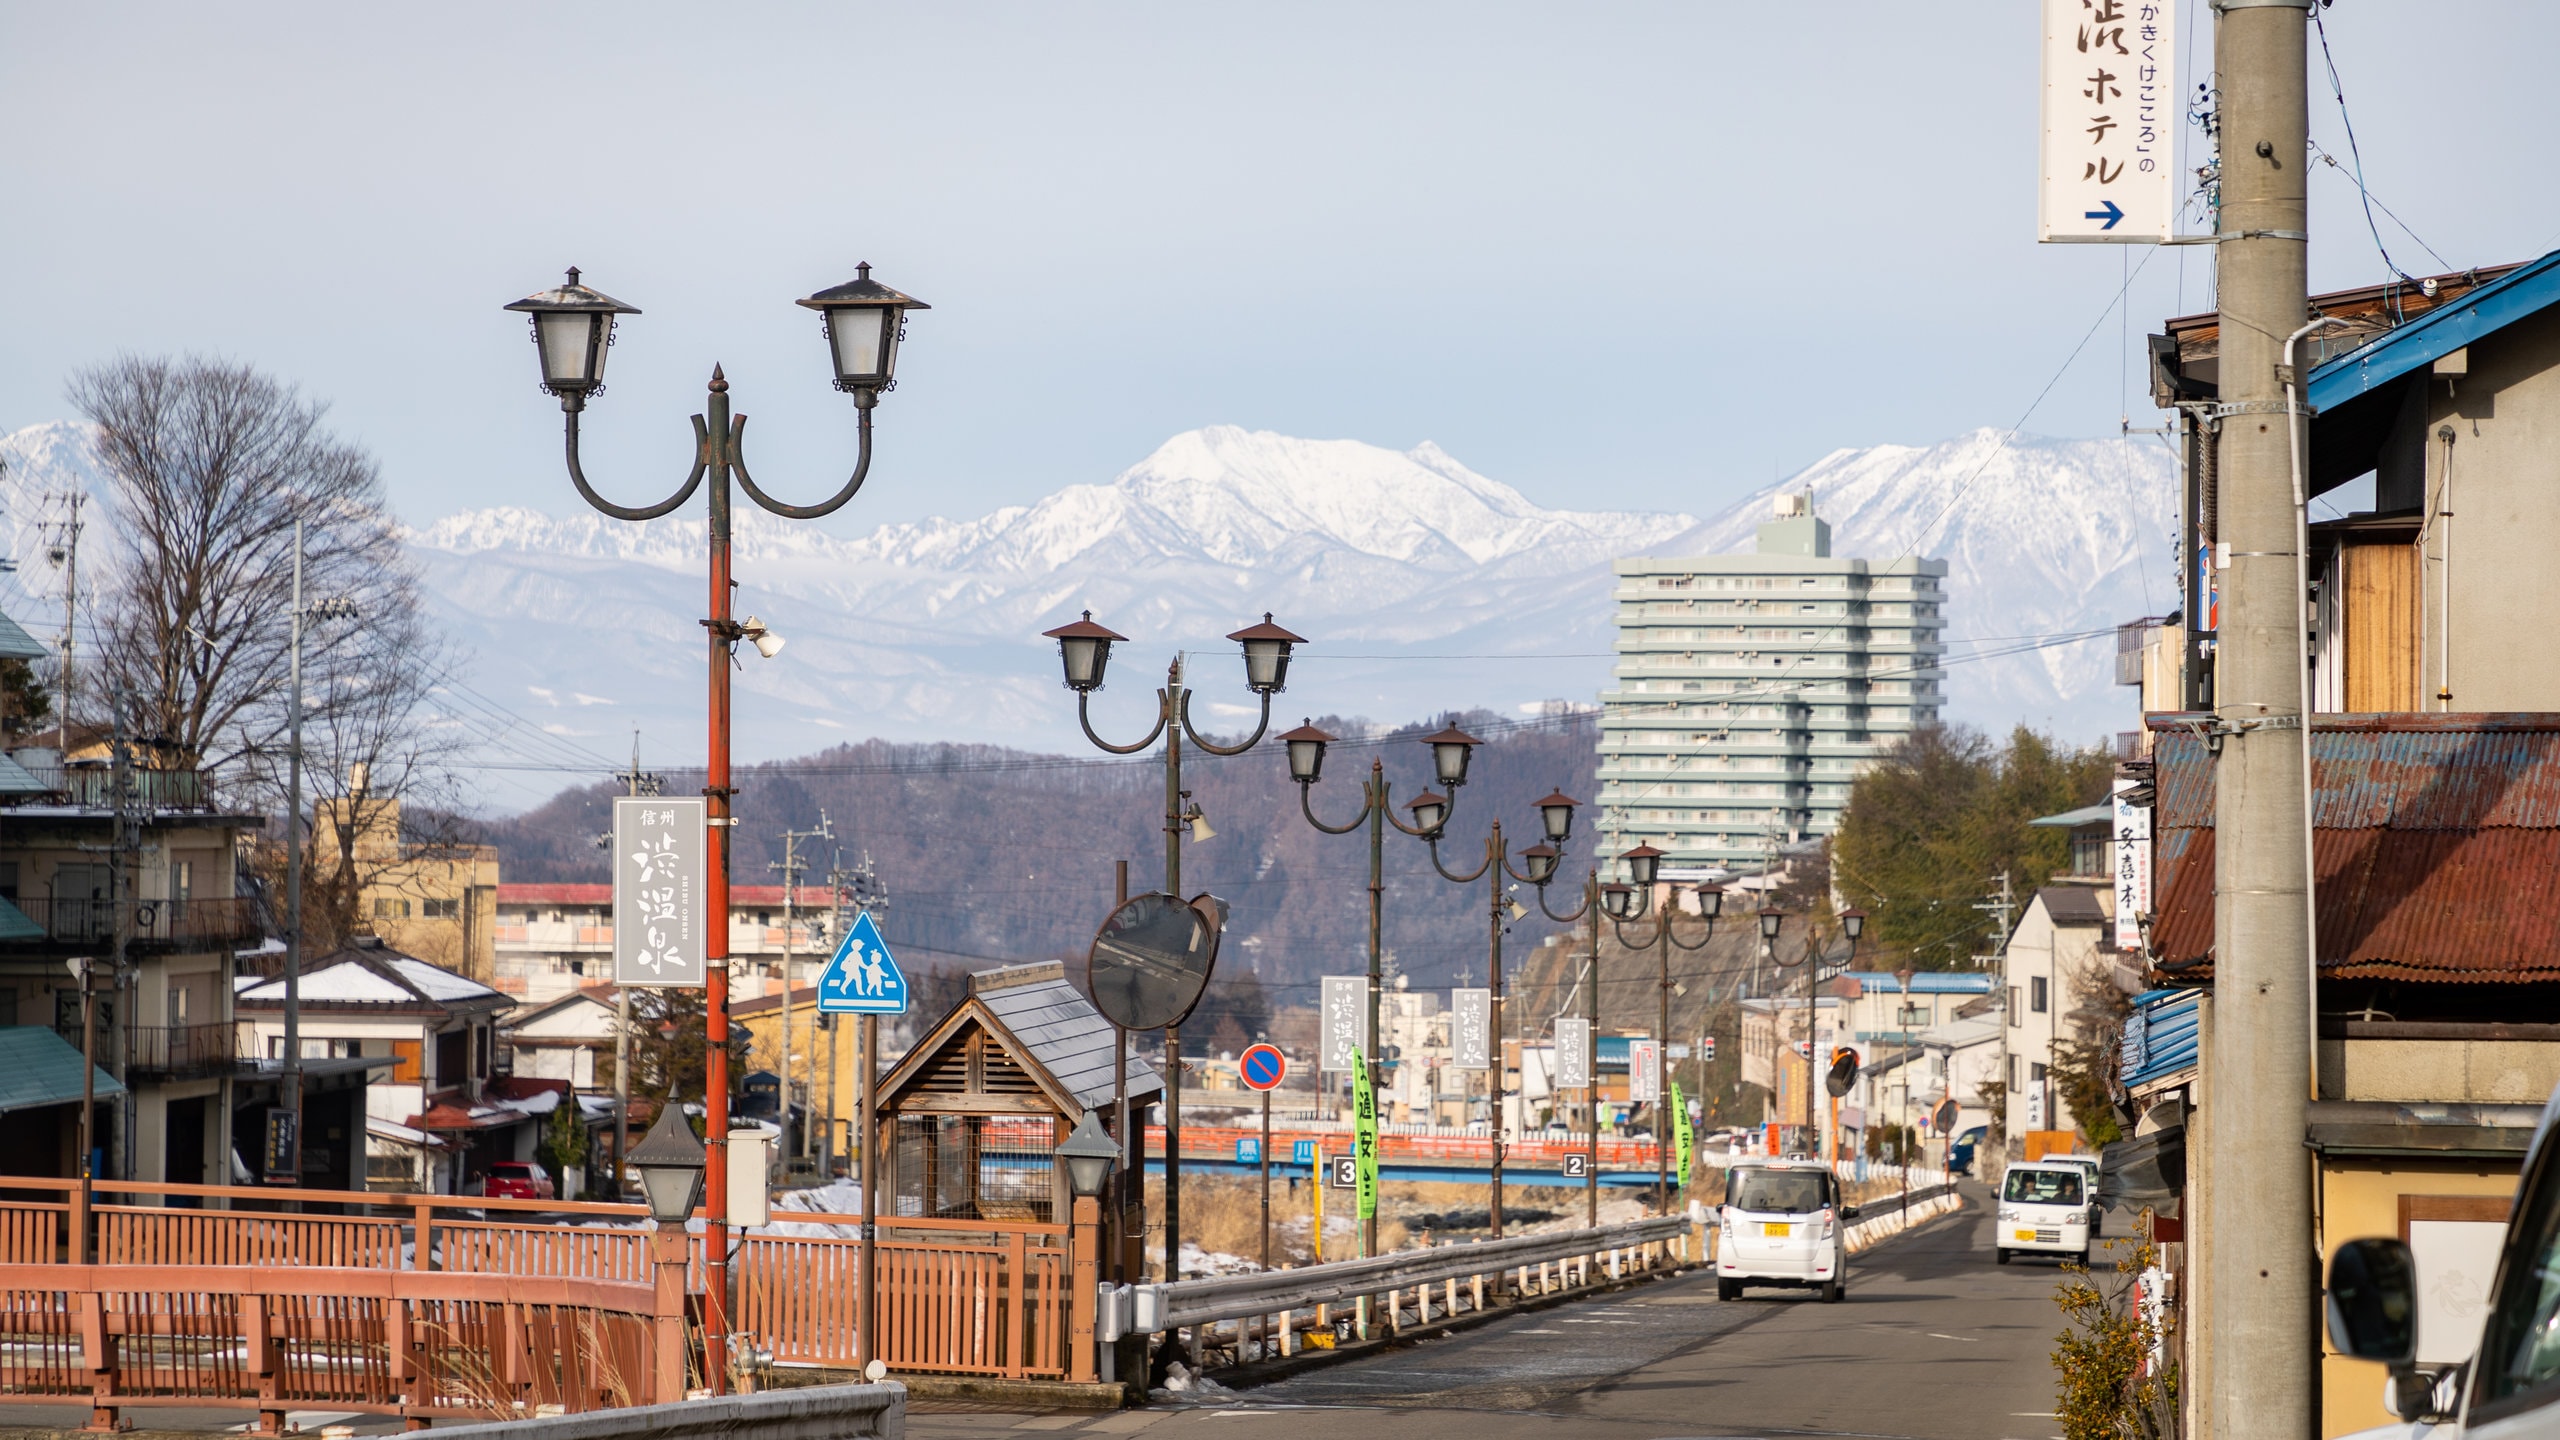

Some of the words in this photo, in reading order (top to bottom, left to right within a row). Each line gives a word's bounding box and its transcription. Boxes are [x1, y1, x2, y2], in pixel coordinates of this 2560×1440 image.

[2137, 0, 2160, 173] かきくけこころ」の
[640, 809, 675, 826] 信州
[632, 832, 687, 975] 渋温泉
[1330, 993, 1356, 1066] 渋温泉
[1460, 1003, 1484, 1064] 渋温泉
[1341, 1161, 1356, 1183] 3
[1570, 1157, 1581, 1174] 2
